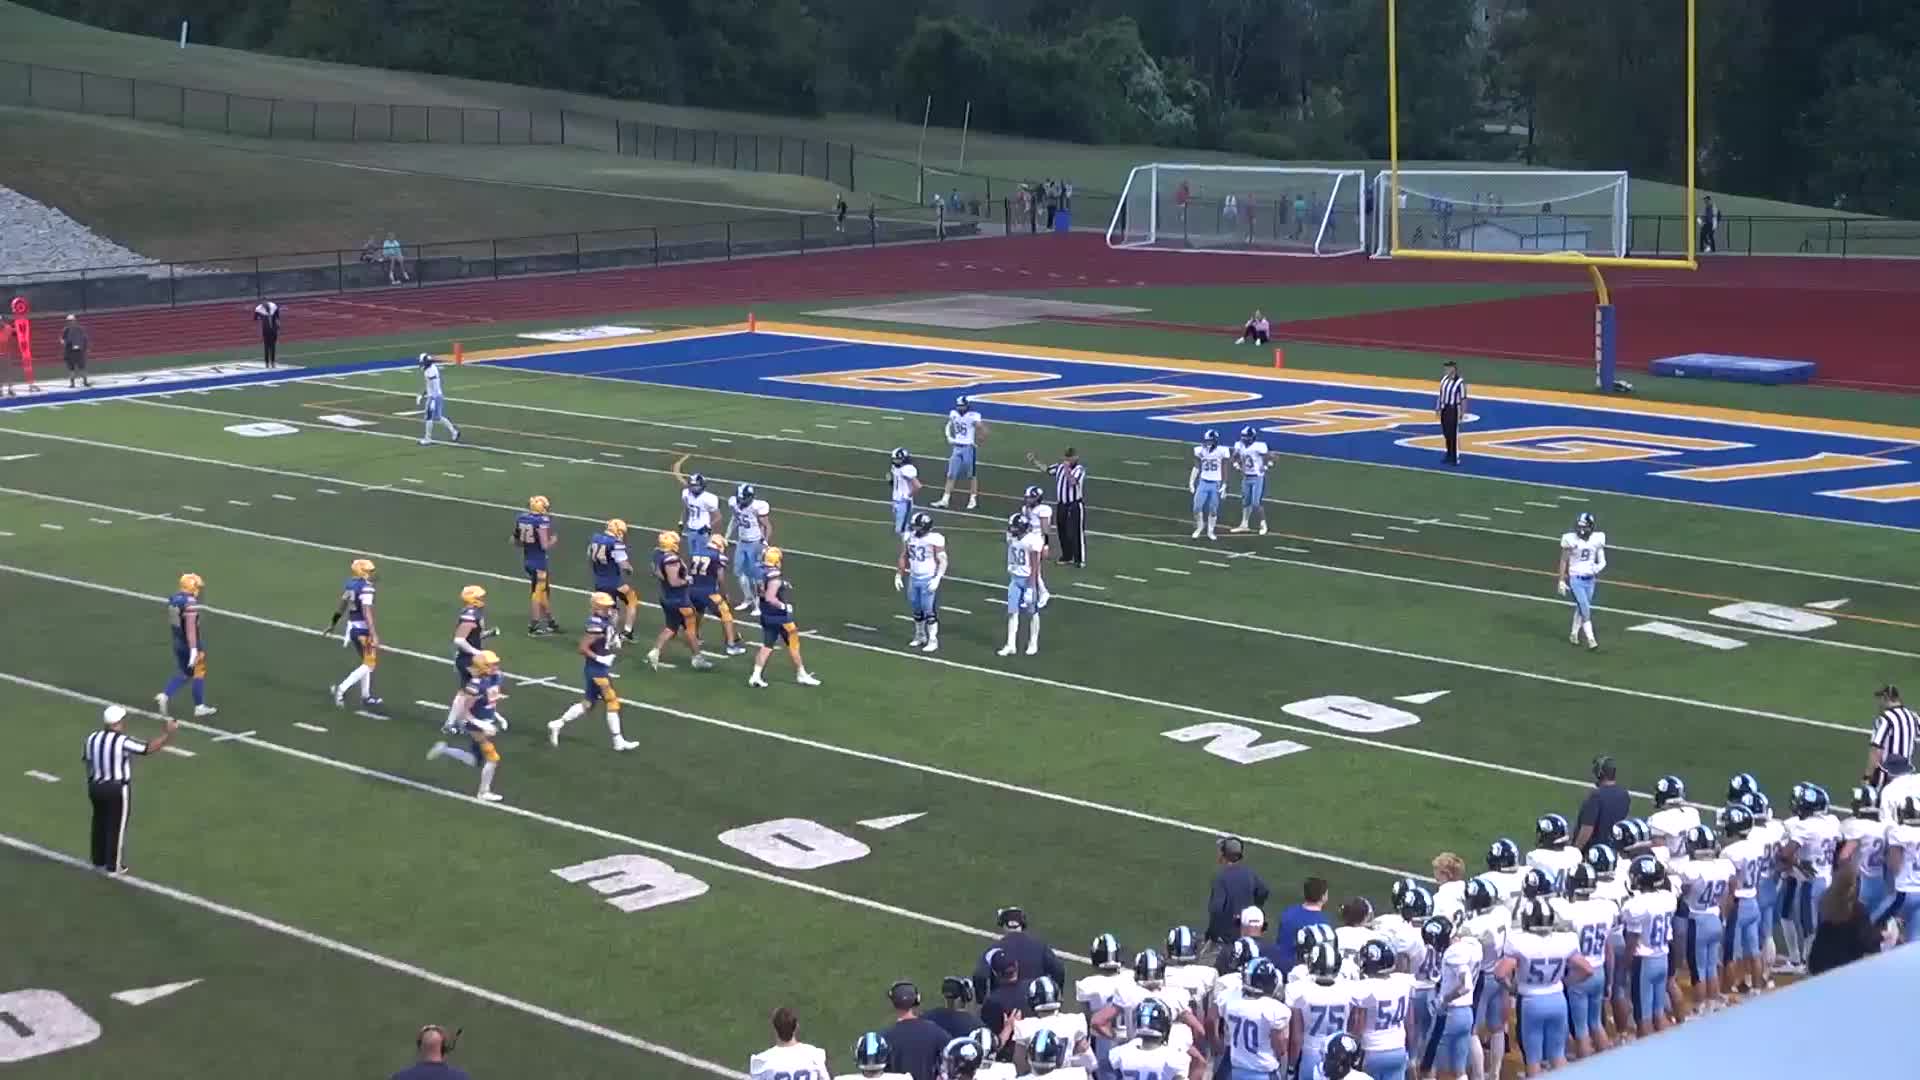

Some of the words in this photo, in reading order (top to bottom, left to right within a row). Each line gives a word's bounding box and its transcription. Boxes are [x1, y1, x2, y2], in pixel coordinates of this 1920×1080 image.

[908, 544, 926, 562] 53
[1528, 958, 1563, 986] 57
[1229, 1015, 1259, 1053] 70
[1309, 1005, 1345, 1036] 75
